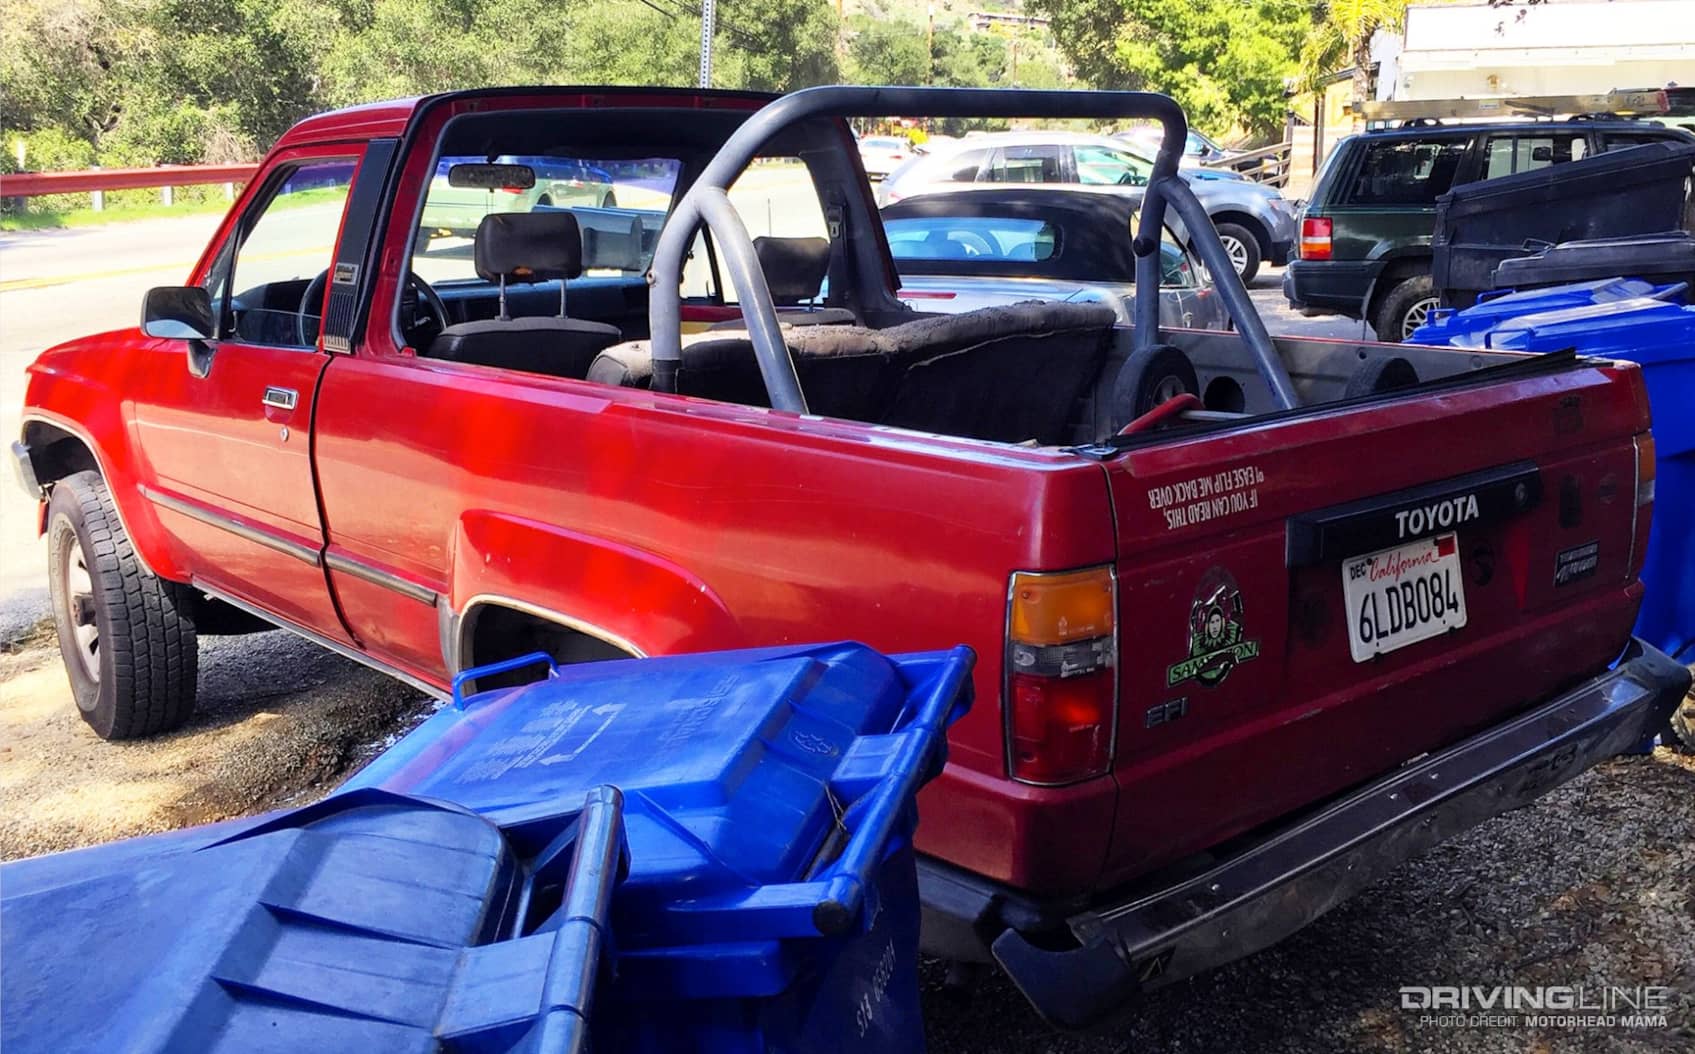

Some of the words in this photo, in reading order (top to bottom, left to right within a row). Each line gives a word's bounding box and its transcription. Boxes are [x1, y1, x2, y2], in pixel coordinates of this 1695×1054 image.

[1173, 480, 1198, 503] BACK
[1198, 476, 1214, 497] ME
[1214, 471, 1232, 494] FLIP
[1148, 485, 1173, 509] OVER
[1212, 496, 1229, 518] CAN
[1231, 491, 1249, 513] YOU
[1249, 488, 1258, 508] IF
[1188, 500, 1211, 524] READ
[1395, 494, 1479, 538] TOYOTA
[1350, 563, 1366, 580] DEC
[1370, 550, 1439, 582] California
[1359, 569, 1459, 643] 6LDB084
[1146, 697, 1187, 728] EFI
